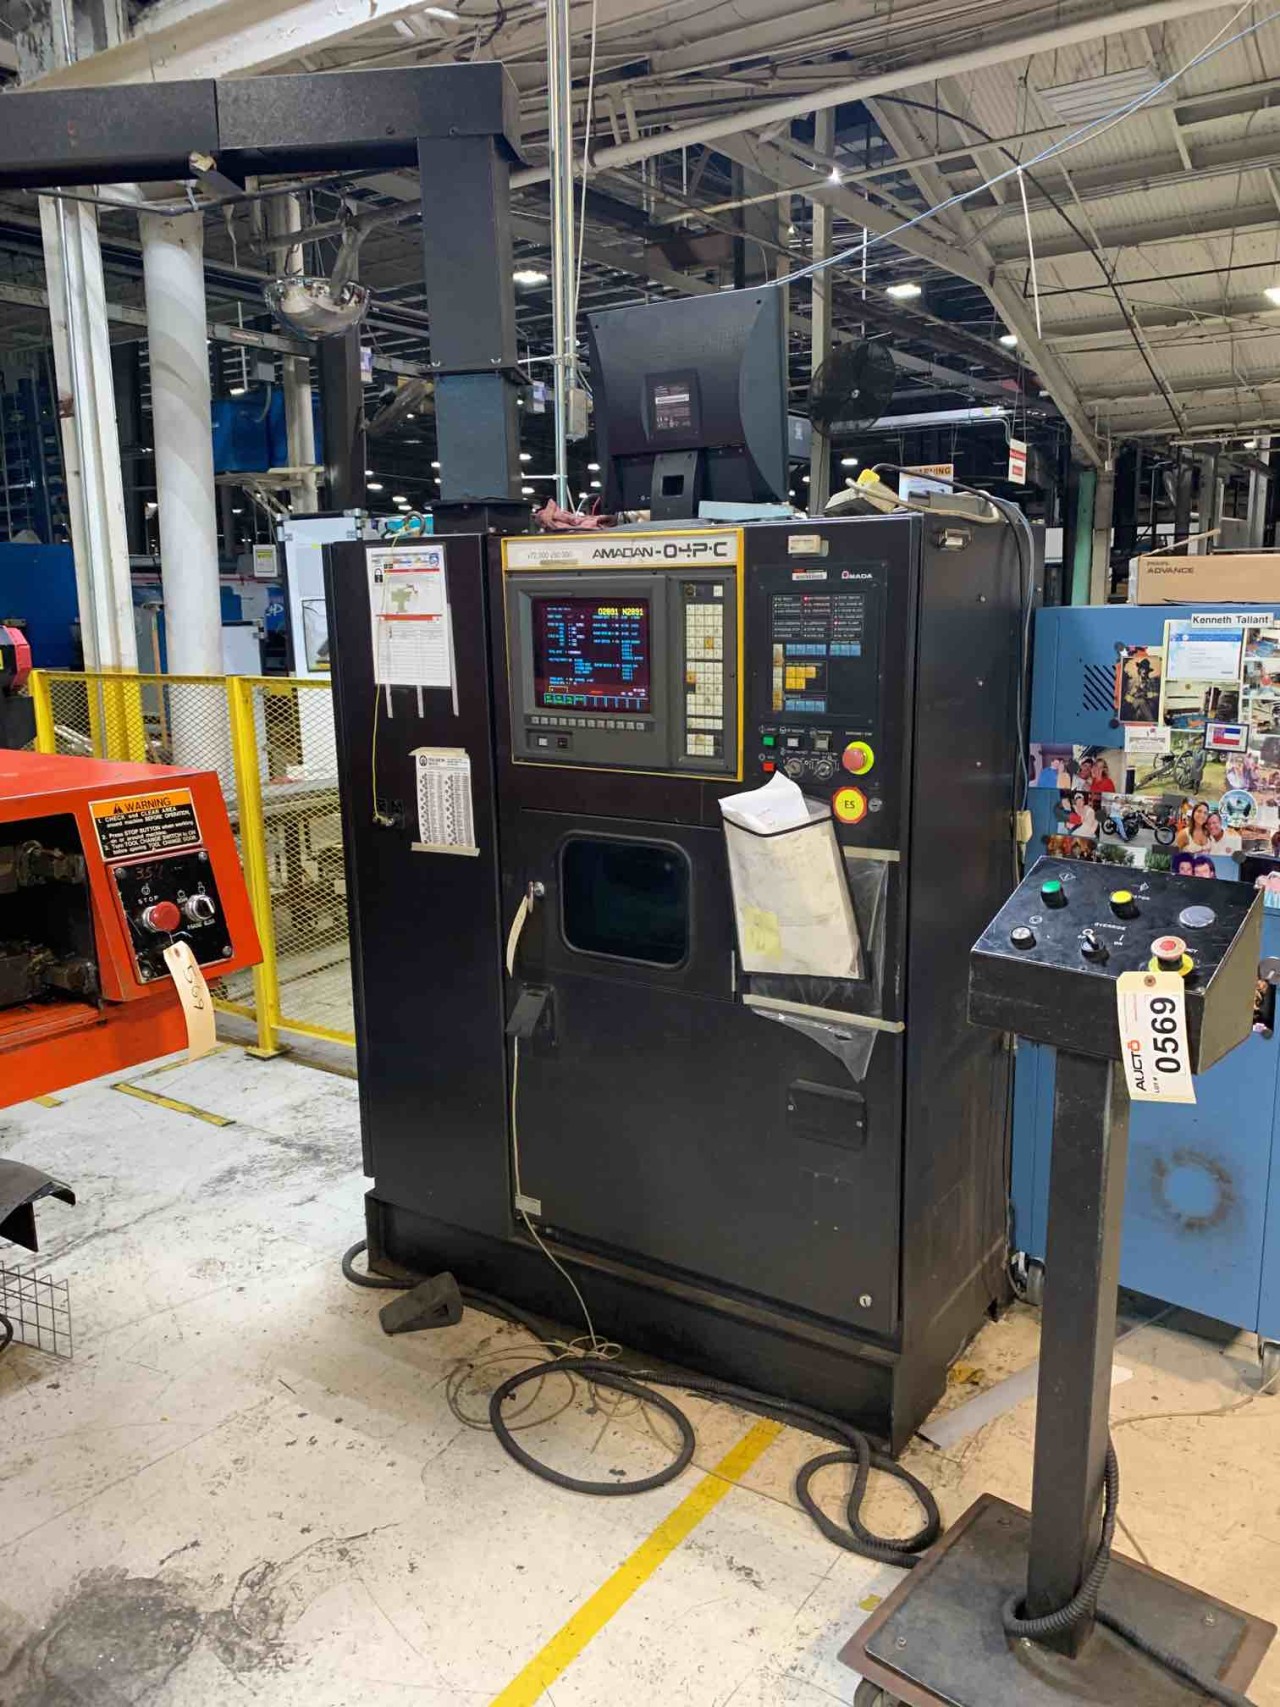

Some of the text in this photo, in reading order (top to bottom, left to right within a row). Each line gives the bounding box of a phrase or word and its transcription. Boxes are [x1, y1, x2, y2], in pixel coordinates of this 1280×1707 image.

[1192, 615, 1232, 624] Kenneth
[124, 797, 171, 812] WARNING
[844, 800, 855, 809] ES
[138, 894, 159, 904] STOP
[1150, 997, 1181, 1074] 0569
